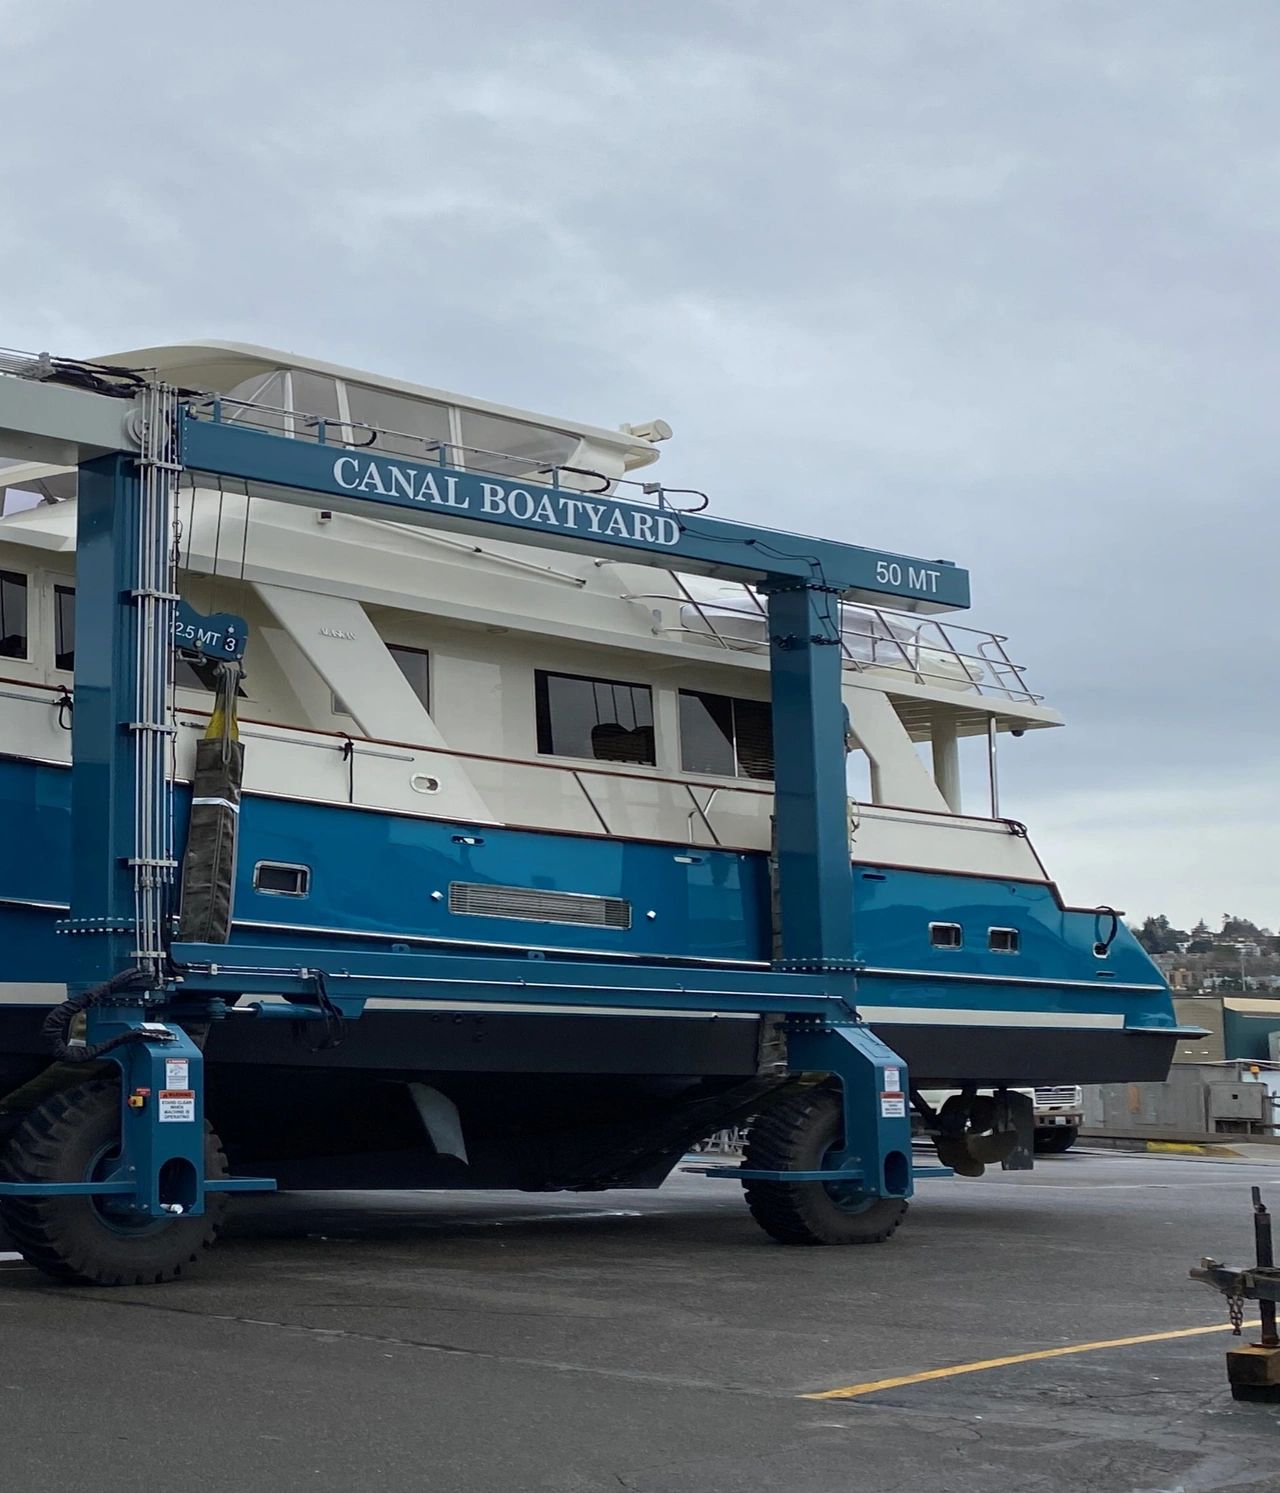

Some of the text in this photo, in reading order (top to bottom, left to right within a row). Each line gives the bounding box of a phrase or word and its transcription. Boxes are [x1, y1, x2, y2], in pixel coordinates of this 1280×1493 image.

[332, 457, 682, 546] CANAL BOATYARD
[877, 561, 941, 592] 50 MT
[197, 629, 221, 645] MT
[225, 638, 236, 650] 3
